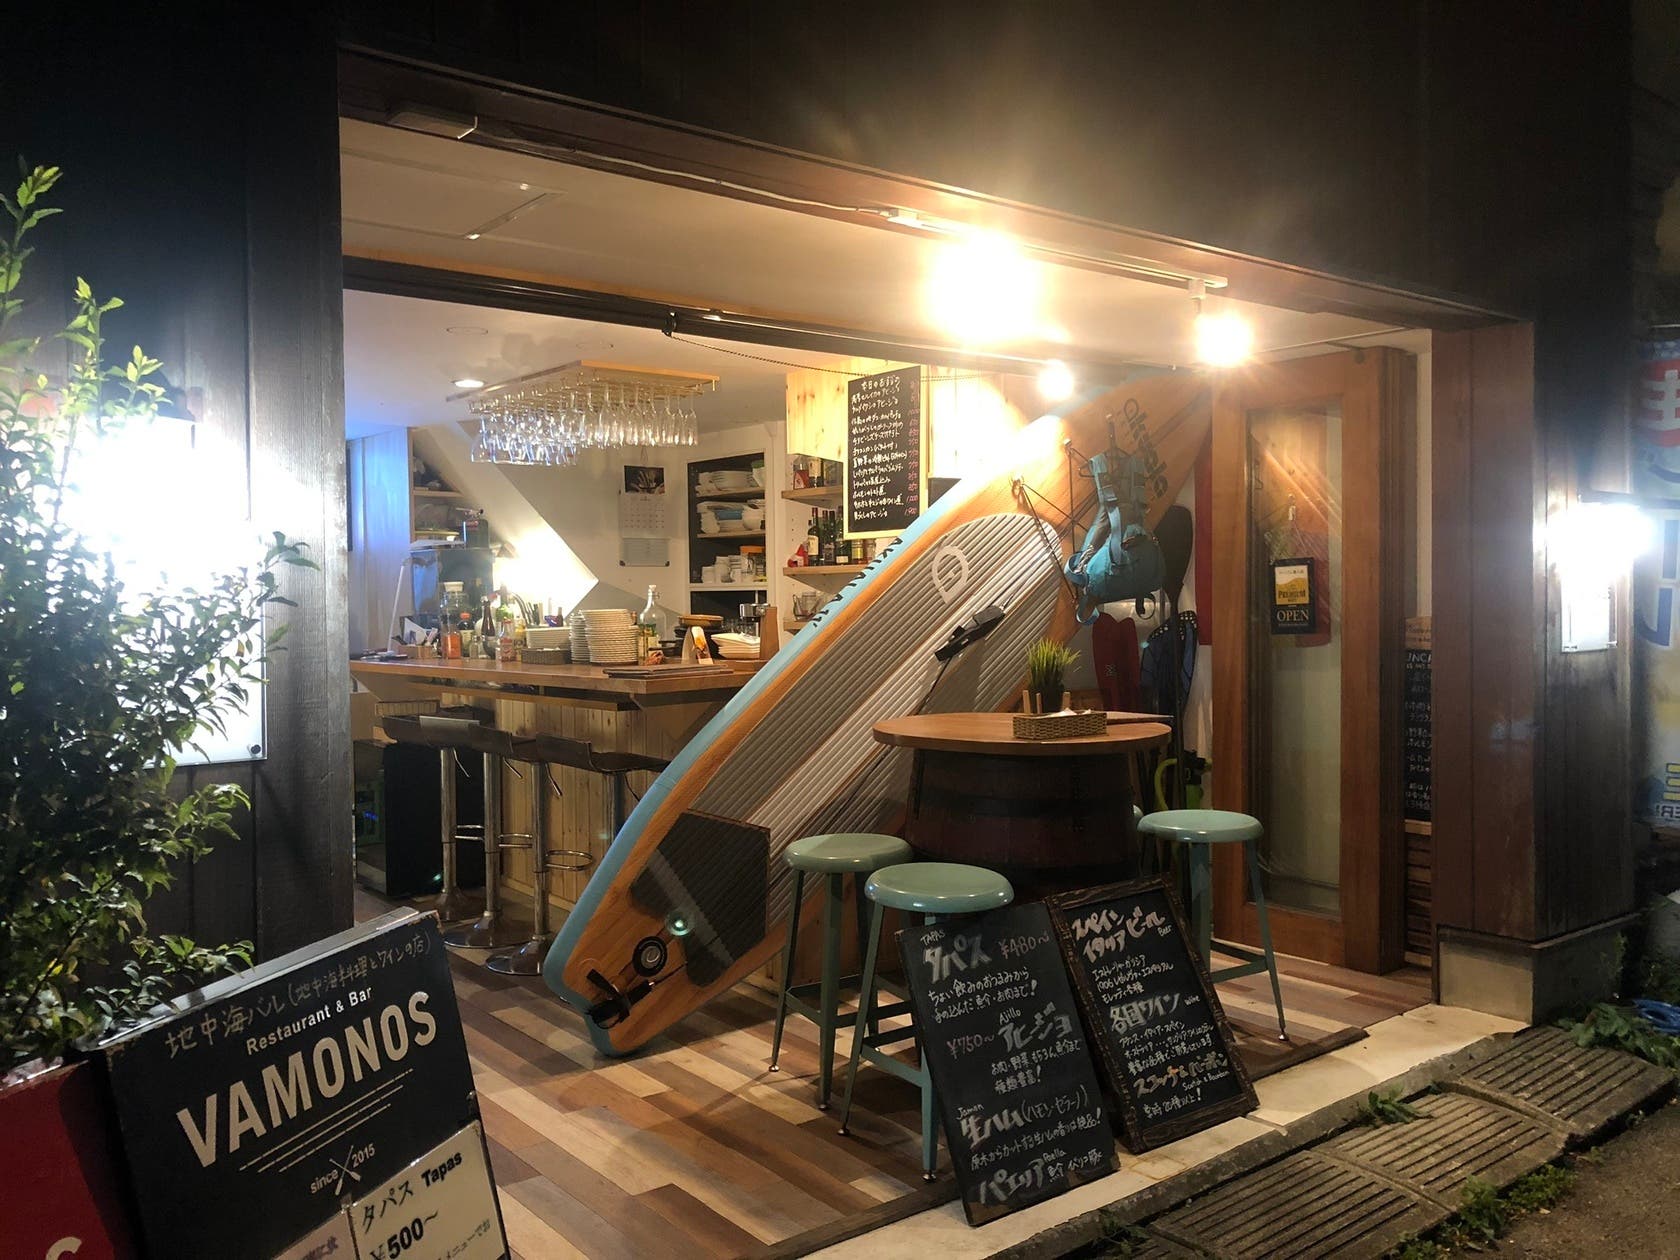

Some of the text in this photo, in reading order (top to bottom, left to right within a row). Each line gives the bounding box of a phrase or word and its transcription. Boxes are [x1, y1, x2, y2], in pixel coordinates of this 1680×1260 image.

[1277, 610, 1309, 621] OPEN
[920, 930, 945, 946] TAPAS
[1083, 929, 1125, 963] イタリア
[1126, 906, 1165, 938] ビール
[922, 934, 992, 983] タパス
[246, 986, 373, 1055] Restaurant & Bar
[998, 1001, 1073, 1053] アヒージョ
[176, 991, 437, 1167] VAMONOS
[310, 1144, 377, 1194] since 2015
[363, 1151, 463, 1234] タパス Tapas
[979, 1157, 1044, 1204] パエリア
